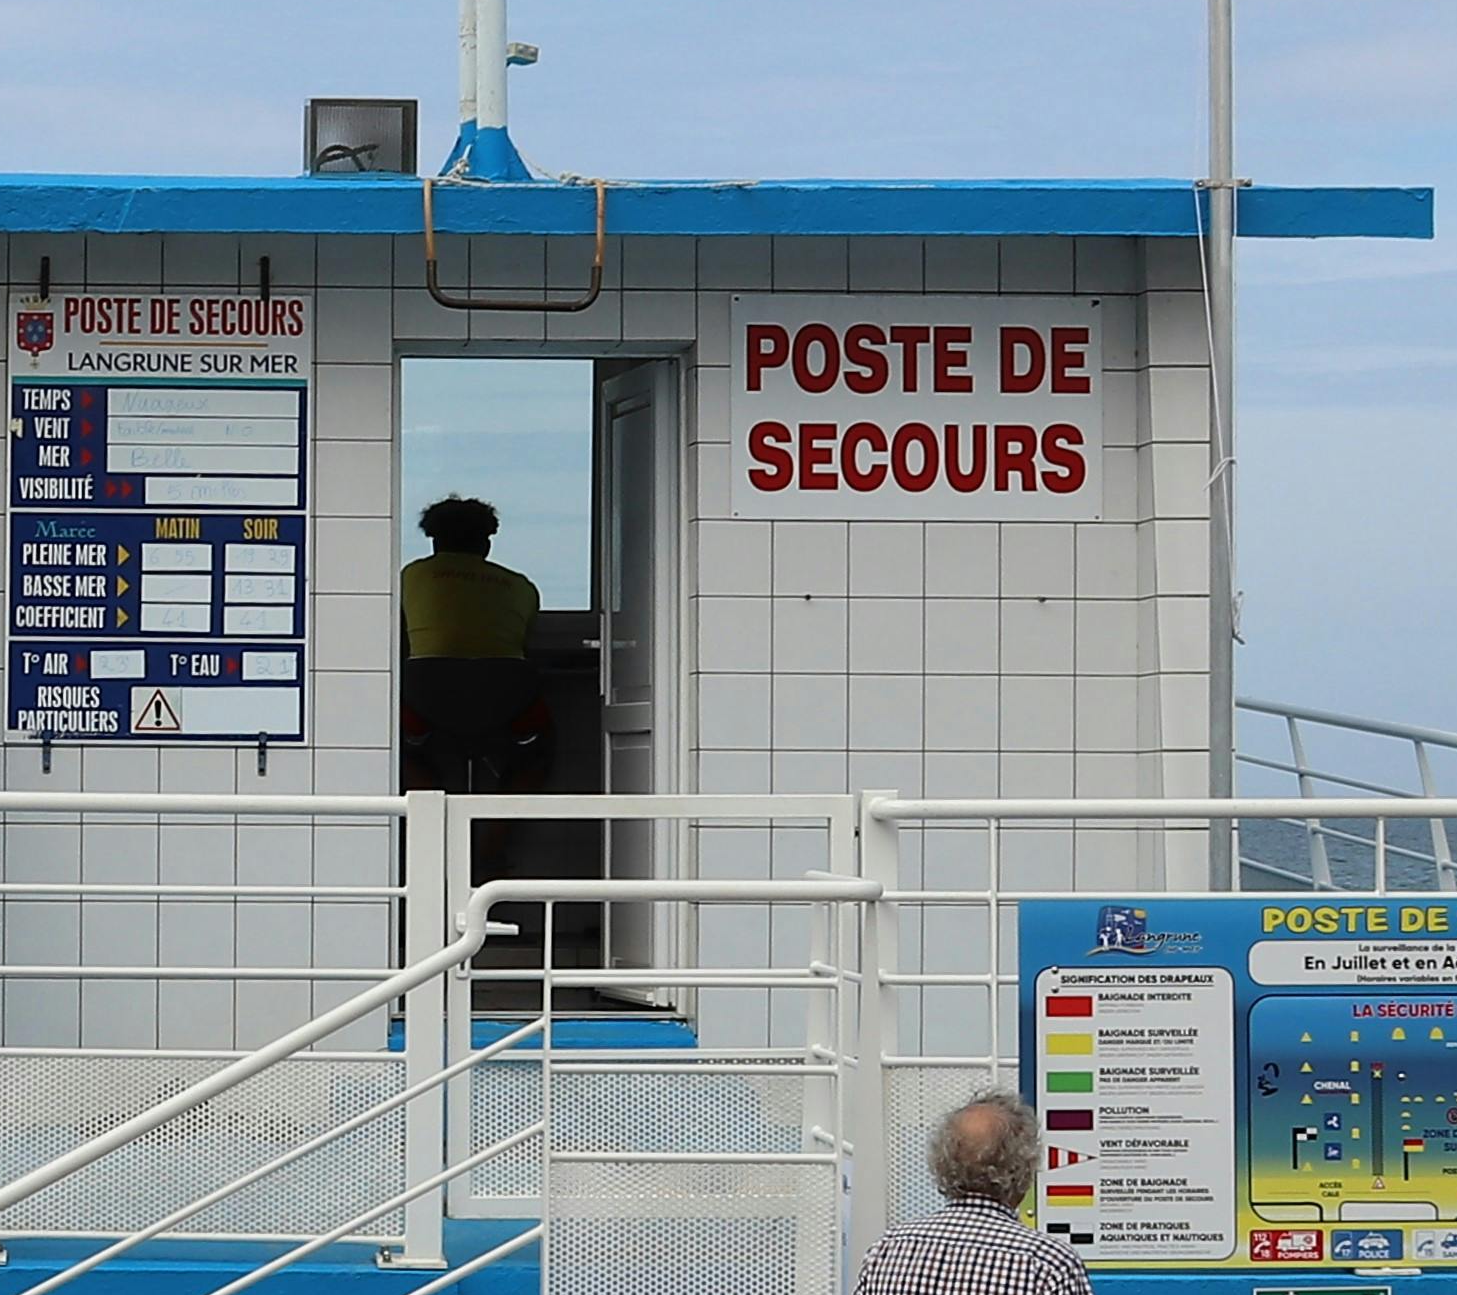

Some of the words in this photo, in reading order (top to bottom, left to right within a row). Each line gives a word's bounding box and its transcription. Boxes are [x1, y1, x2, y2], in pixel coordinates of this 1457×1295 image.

[64, 297, 141, 334] POSTE
[150, 299, 181, 335] DE
[189, 299, 304, 336] SECOURS
[68, 352, 193, 372] LANGRUNE
[200, 354, 242, 373] SUR
[250, 355, 298, 373] MER
[746, 322, 975, 395] POSTE
[999, 326, 1091, 395] DE
[22, 388, 71, 411] TEMPS
[34, 417, 71, 439] VENT
[38, 446, 71, 467] MER
[747, 421, 1087, 494] SECOURS
[20, 475, 93, 500] VISIBILITÉ
[35, 520, 96, 539] Marée
[155, 518, 200, 539] MATIN
[243, 518, 278, 540] SOIR
[22, 543, 72, 566] PLEINE
[75, 544, 106, 566] MER
[23, 575, 72, 597] BASSE
[75, 575, 106, 597] MER
[16, 606, 106, 629] COEFFICIENT
[43, 653, 68, 675] AIR
[191, 655, 220, 676] EAU
[38, 686, 100, 708] RISQUES
[18, 710, 119, 733] PARTICULIERS
[1262, 907, 1388, 933] POSTE
[1400, 908, 1451, 933] DE
[1373, 944, 1429, 952] surveillance
[1432, 944, 1444, 952] de
[1446, 944, 1455, 952] la
[1304, 956, 1326, 970] En
[1331, 955, 1387, 970] Juillet
[1392, 957, 1410, 970] et
[1416, 959, 1437, 970] en
[1060, 975, 1135, 984] SIGNIFICATION
[1138, 975, 1157, 984] DES
[1160, 974, 1214, 984] DRAPEAUX
[1098, 993, 1144, 1001] BAIGNADE
[1147, 993, 1192, 1001] INTERDITE
[1353, 1004, 1372, 1017] LA
[1378, 1000, 1453, 1017] SÉCURITÉ
[1098, 1029, 1145, 1037] BAIGNADE
[1148, 1028, 1198, 1037] SURVEILLÉE
[1100, 1067, 1146, 1075] BAIGNADE
[1149, 1066, 1199, 1075] SURVEILLÉE
[1314, 1081, 1351, 1090] CHENAL
[1099, 1107, 1149, 1115] POLLUTION
[1125, 1138, 1189, 1147] DÉFAVORABLE
[1423, 1130, 1450, 1138] ZONE
[1319, 1181, 1342, 1189] ACCÈS
[1141, 1223, 1190, 1231] PRATIQUES
[1100, 1234, 1157, 1242] AQUATIQUES
[1173, 1233, 1224, 1242] NAUTIQUES
[1254, 1233, 1267, 1241] 112
[1277, 1251, 1319, 1259] POMPIERS
[1359, 1250, 1390, 1258] POLICE
